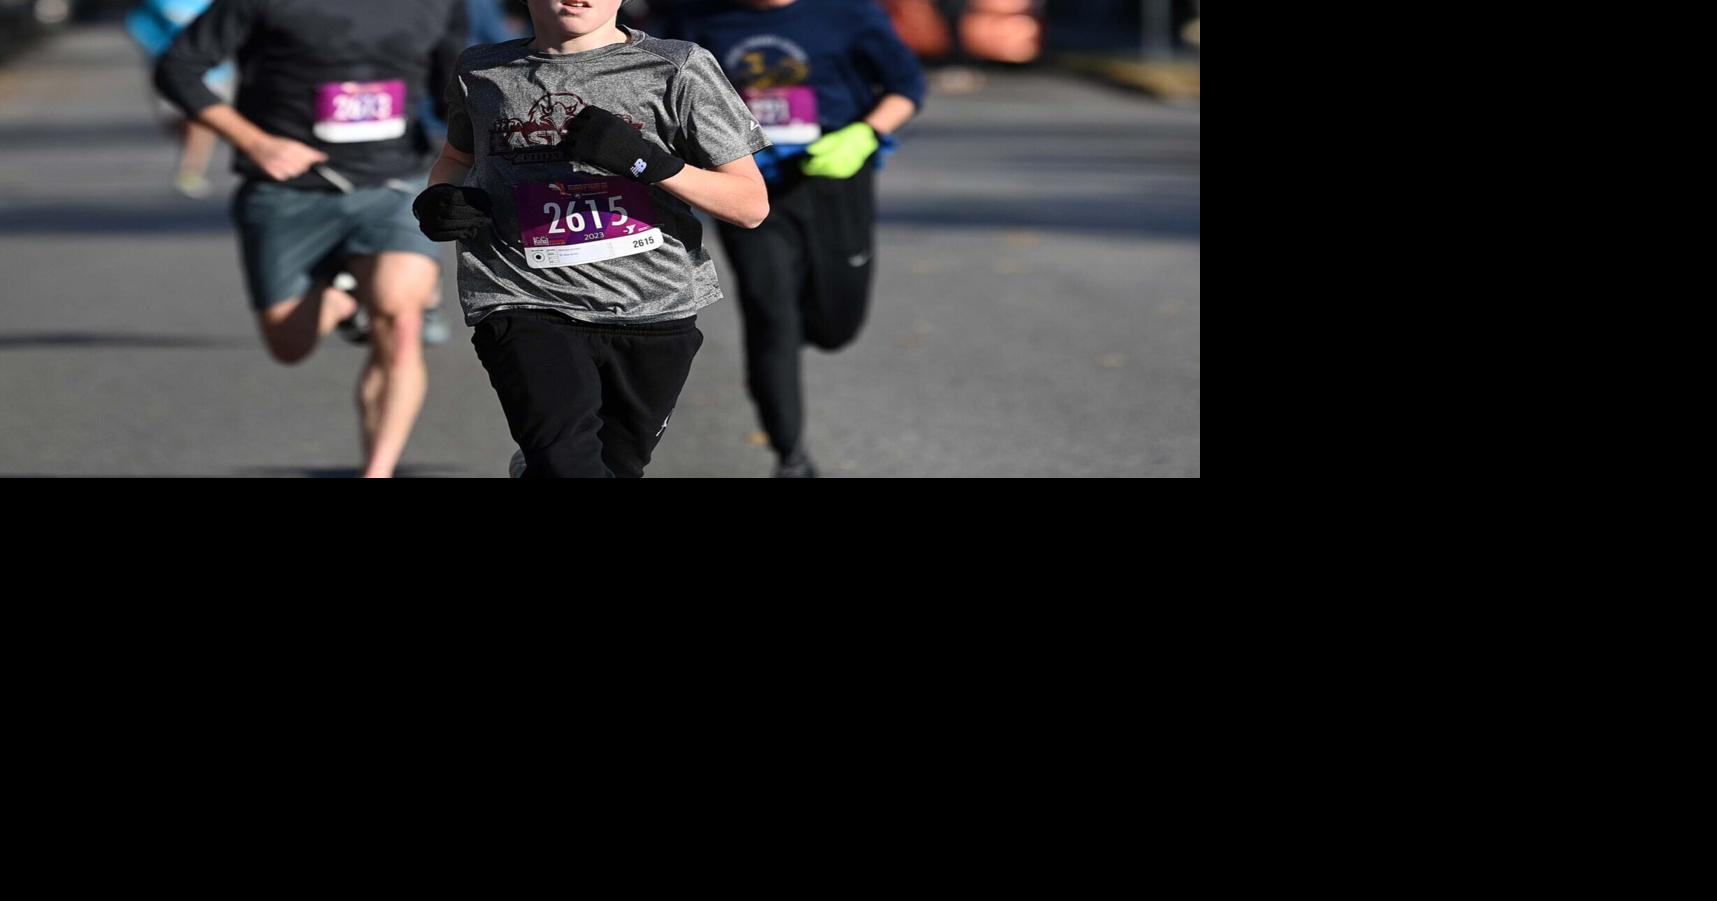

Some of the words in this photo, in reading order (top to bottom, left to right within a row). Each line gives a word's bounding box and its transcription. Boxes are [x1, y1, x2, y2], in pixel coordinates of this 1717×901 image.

[543, 195, 629, 234] 2615
[583, 231, 605, 241] 2023
[632, 236, 655, 248] 2615
